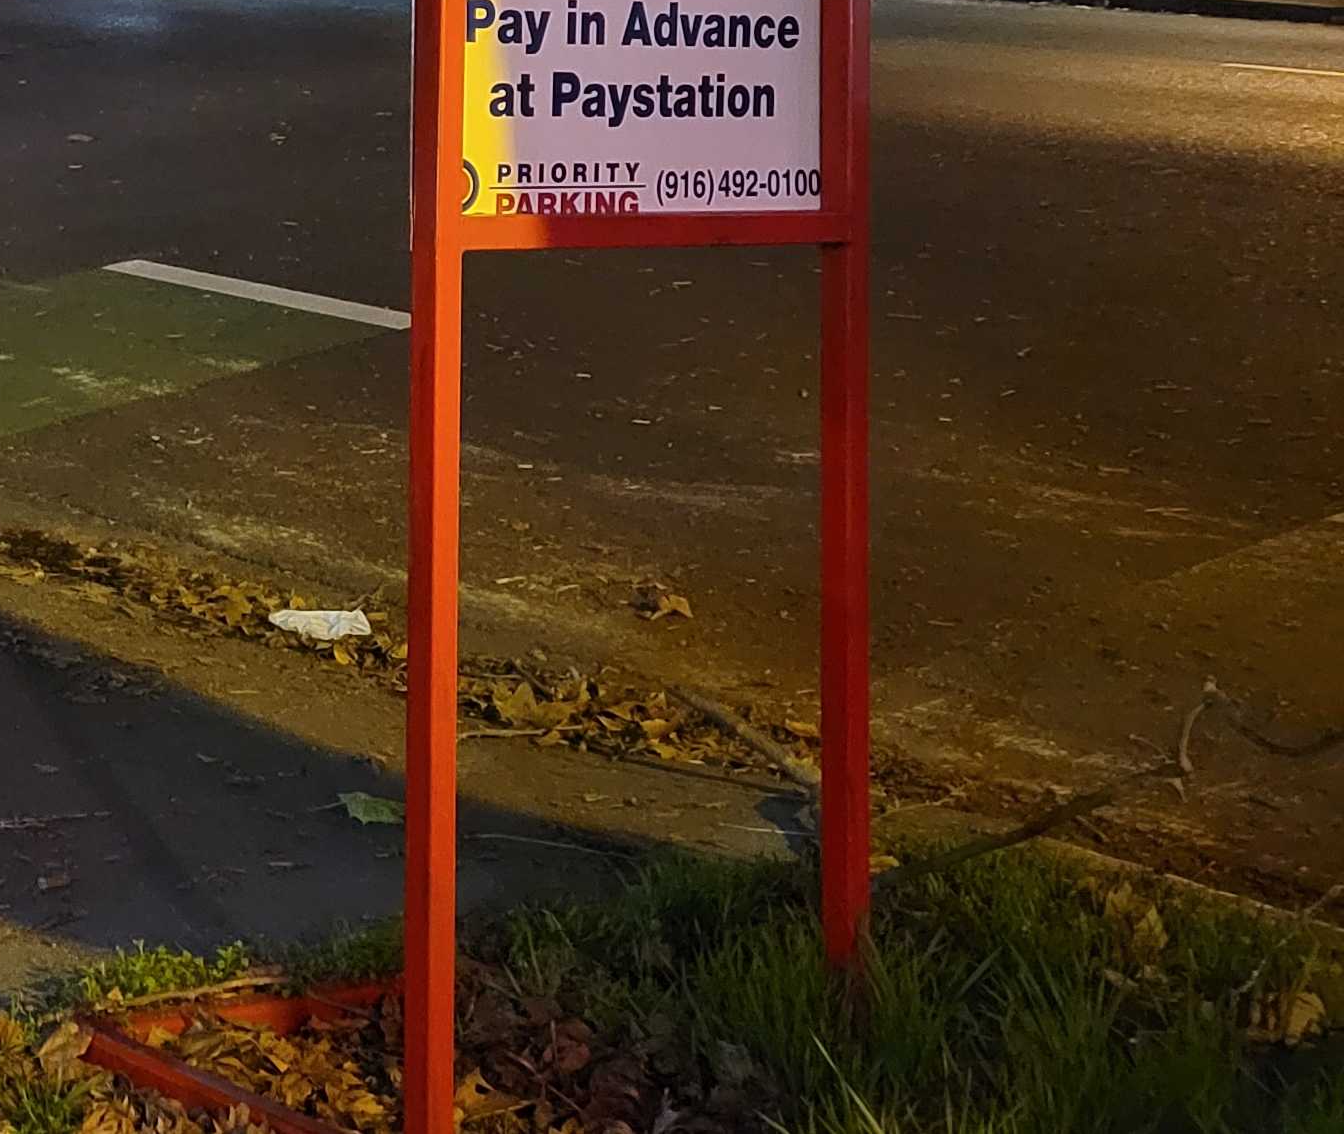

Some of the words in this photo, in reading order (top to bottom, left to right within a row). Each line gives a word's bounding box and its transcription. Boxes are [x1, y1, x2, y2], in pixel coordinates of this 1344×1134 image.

[567, 0, 605, 45] in
[621, 1, 800, 48] Advance
[489, 74, 535, 117] at
[552, 72, 775, 128] Paystation
[498, 163, 640, 183] PRIORITY
[496, 191, 640, 215] PARKING
